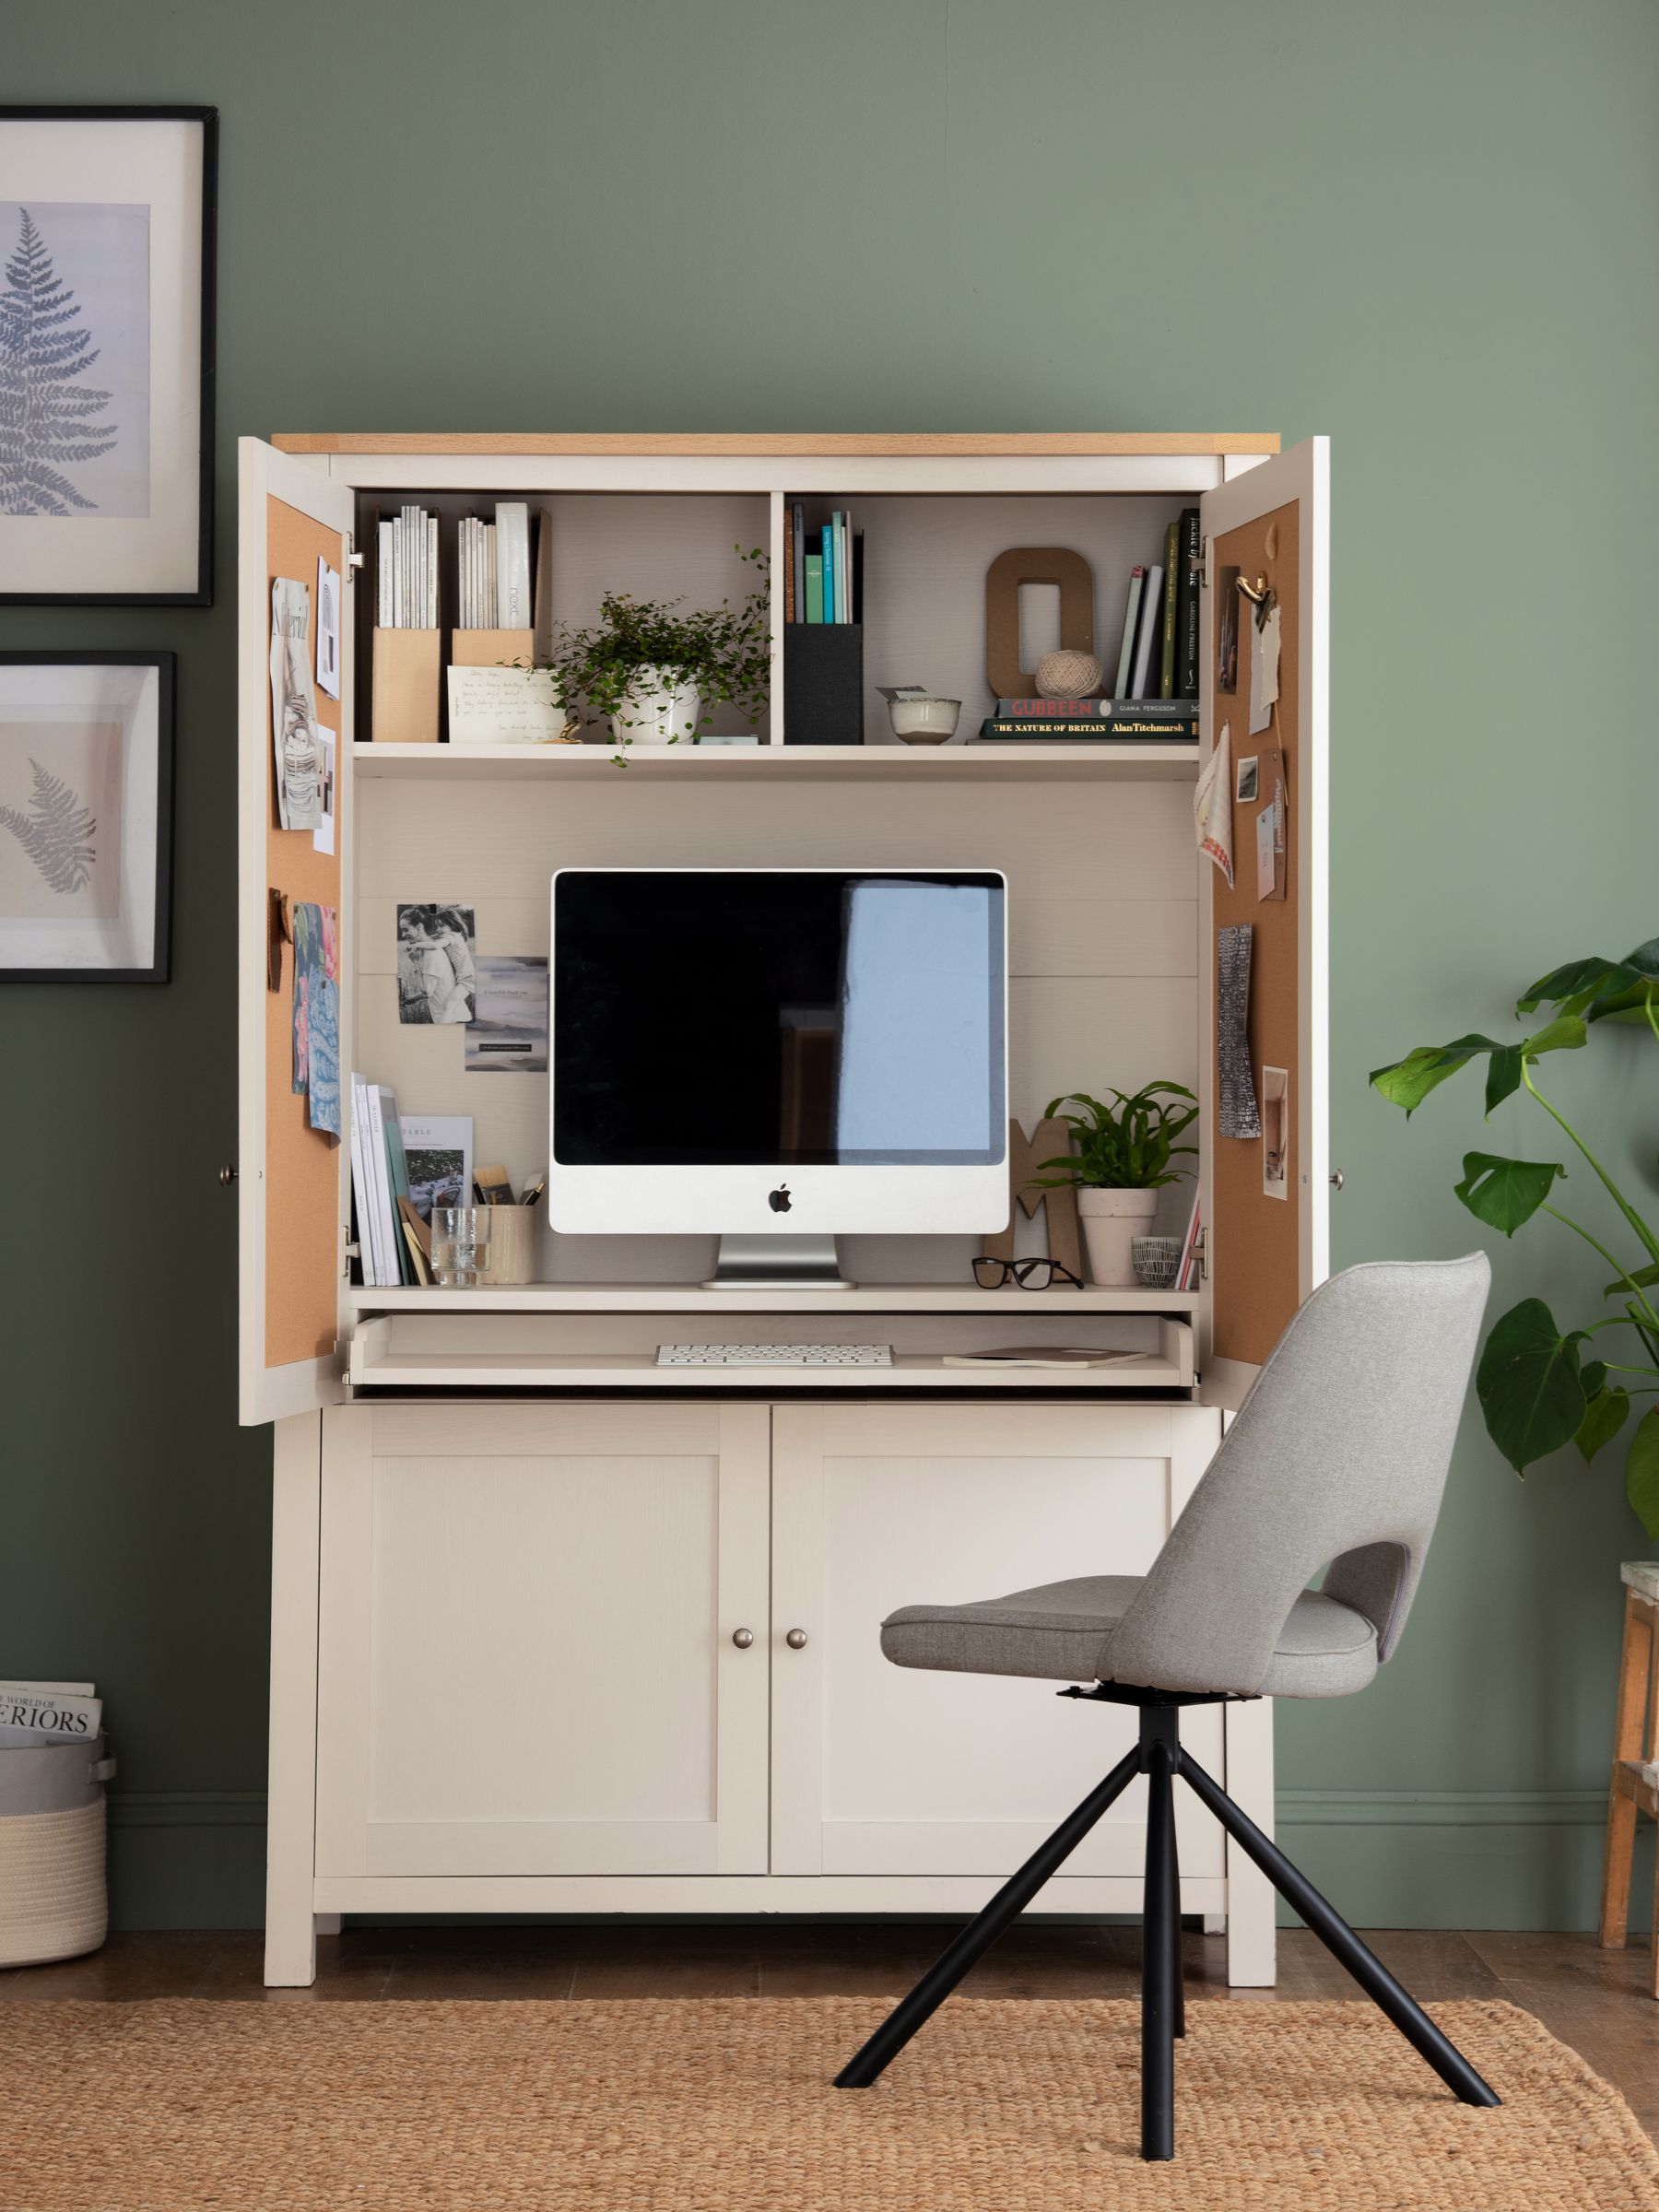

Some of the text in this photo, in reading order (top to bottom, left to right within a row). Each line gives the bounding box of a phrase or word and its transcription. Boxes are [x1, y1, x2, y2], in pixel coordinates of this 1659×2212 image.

[509, 587, 519, 614] next
[1188, 601, 1196, 631] CAROLINE
[1012, 700, 1091, 716] GUBBEEN
[993, 724, 1106, 733] THE NATURE OF BRITAIN
[7, 1696, 42, 1707] WORLD
[0, 1705, 88, 1734] ERIORS
